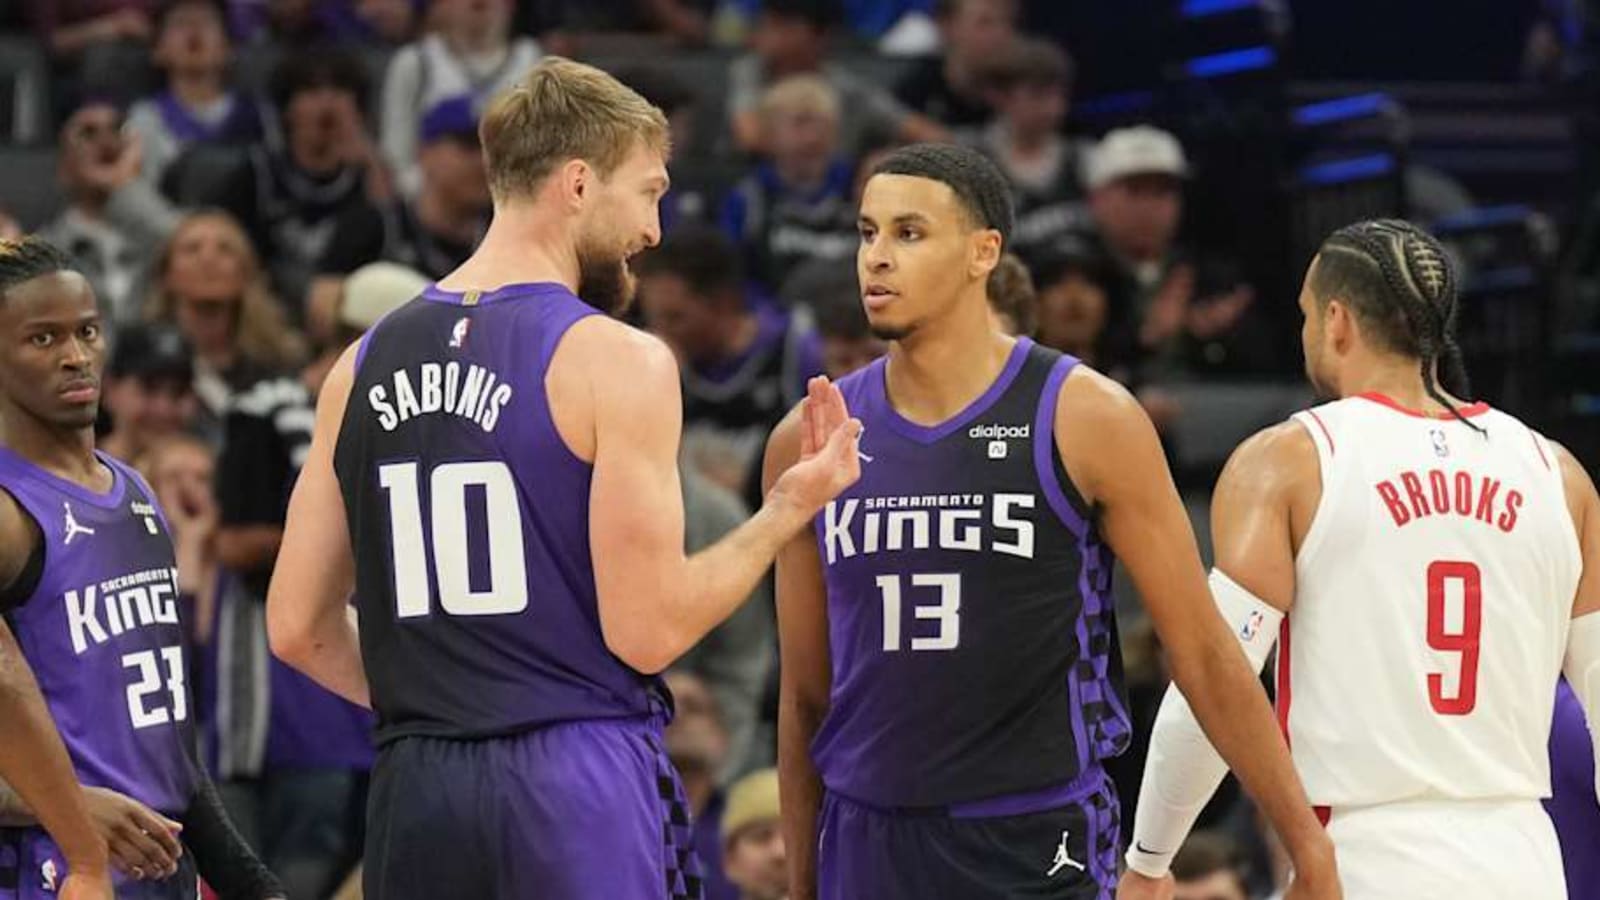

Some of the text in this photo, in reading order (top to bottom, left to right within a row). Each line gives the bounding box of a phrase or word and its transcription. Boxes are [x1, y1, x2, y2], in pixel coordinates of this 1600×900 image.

[368, 361, 512, 432] SABONIS
[968, 423, 1030, 440] dialpad
[379, 461, 528, 618] 10
[1376, 469, 1524, 533] BROOKS
[64, 567, 179, 655] KING
[876, 573, 961, 651] 13
[1426, 560, 1482, 716] 9
[122, 646, 187, 729] 23
